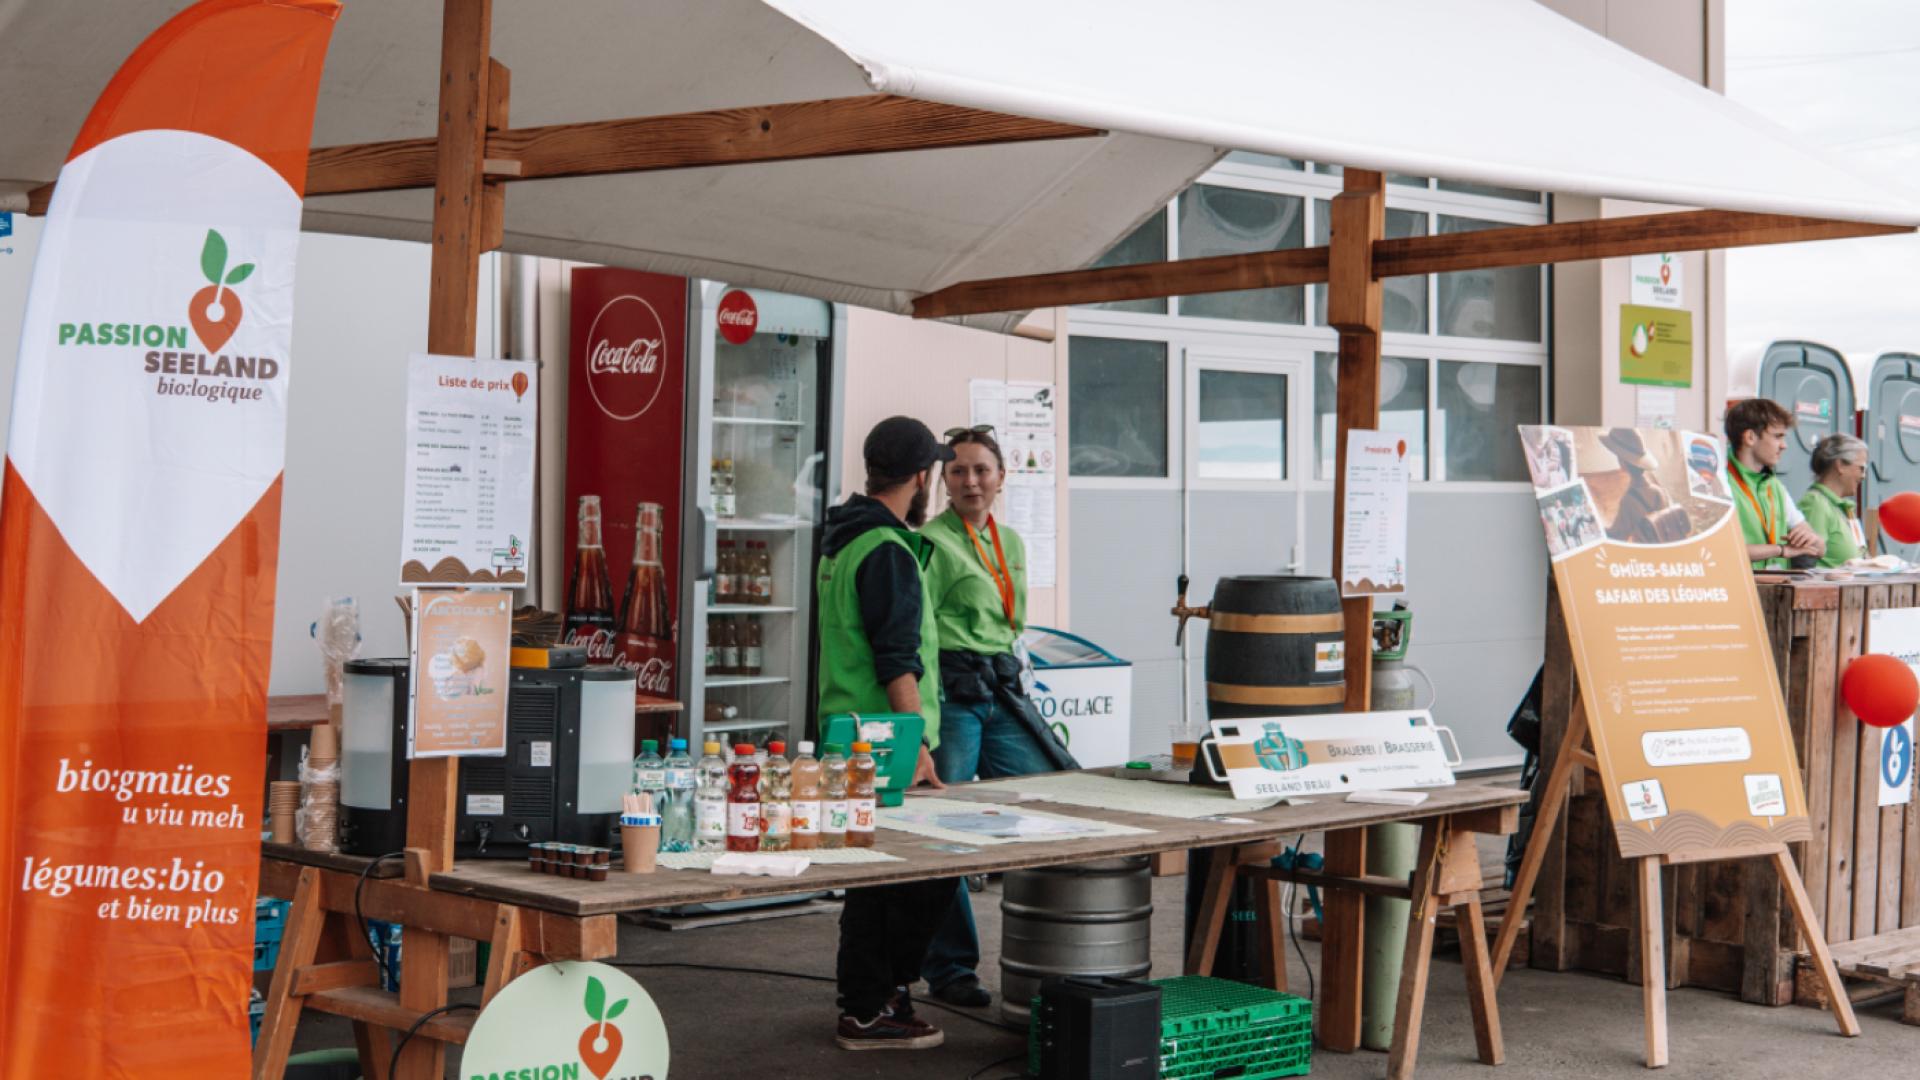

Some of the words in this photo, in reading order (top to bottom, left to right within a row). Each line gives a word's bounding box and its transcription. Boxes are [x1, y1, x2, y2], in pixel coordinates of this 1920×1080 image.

[58, 322, 188, 349] PASSION
[144, 351, 279, 380] SEELAND
[591, 338, 662, 374] Coca-Cola
[156, 376, 263, 403] bio:logique
[438, 376, 467, 388] Liste
[470, 378, 484, 389] de
[487, 381, 510, 392] prix
[1609, 559, 1705, 578] GMÜES-SAFARI
[1595, 589, 1642, 604] SAFARI
[1646, 587, 1669, 602] DES
[1671, 584, 1729, 602] LÉGUMES
[1061, 696, 1113, 717] GLACE
[56, 758, 231, 802] bio:gmües
[1256, 782, 1302, 794] SEELAND
[122, 807, 138, 824] u
[145, 802, 183, 826] viu
[190, 804, 245, 829] meh
[21, 856, 225, 897] légumes:bio
[98, 900, 120, 919] et
[127, 895, 180, 922] bien
[185, 899, 240, 929] plus
[470, 1062, 579, 1080] SSION
